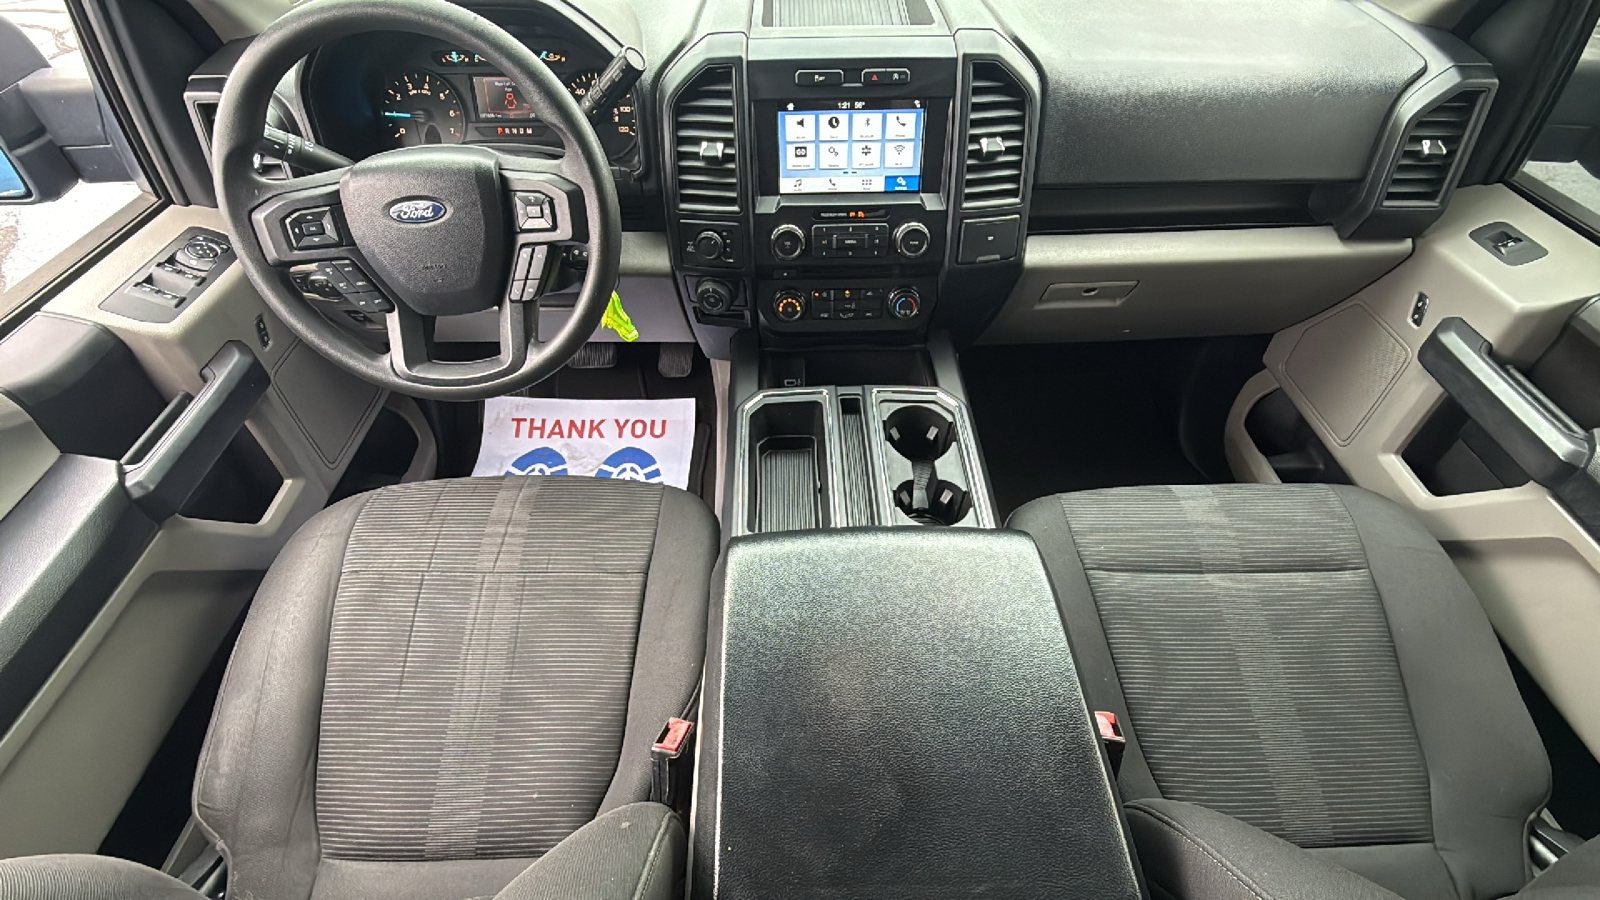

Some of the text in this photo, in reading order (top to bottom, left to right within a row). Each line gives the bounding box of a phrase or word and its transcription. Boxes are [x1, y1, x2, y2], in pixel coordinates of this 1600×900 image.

[575, 88, 586, 96] 40
[400, 204, 434, 219] Ford
[511, 417, 667, 439] THANK YOU
